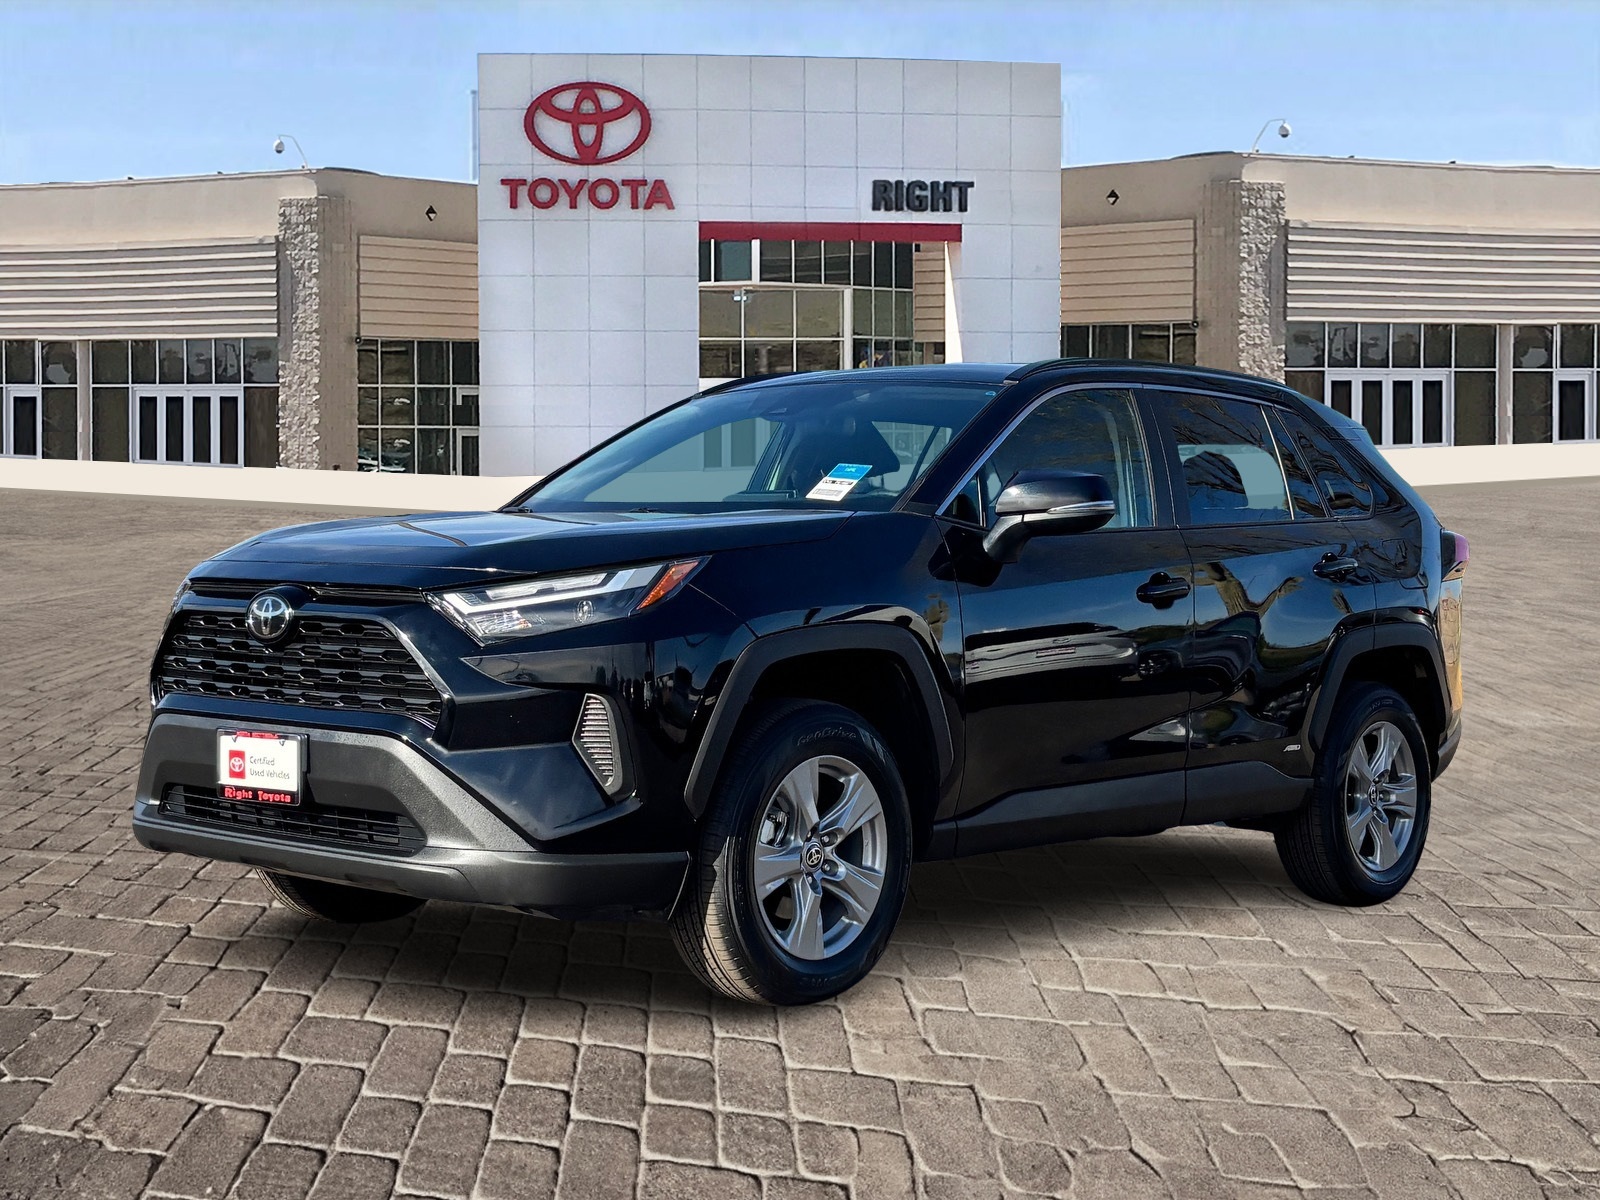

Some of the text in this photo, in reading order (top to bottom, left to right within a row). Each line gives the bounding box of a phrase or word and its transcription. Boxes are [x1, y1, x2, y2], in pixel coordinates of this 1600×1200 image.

[500, 177, 675, 210] TOYOTA
[872, 179, 975, 212] RIGHT
[249, 755, 275, 766] Certified
[249, 768, 290, 780] Used Vehicles
[224, 785, 291, 803] Right Toyota
